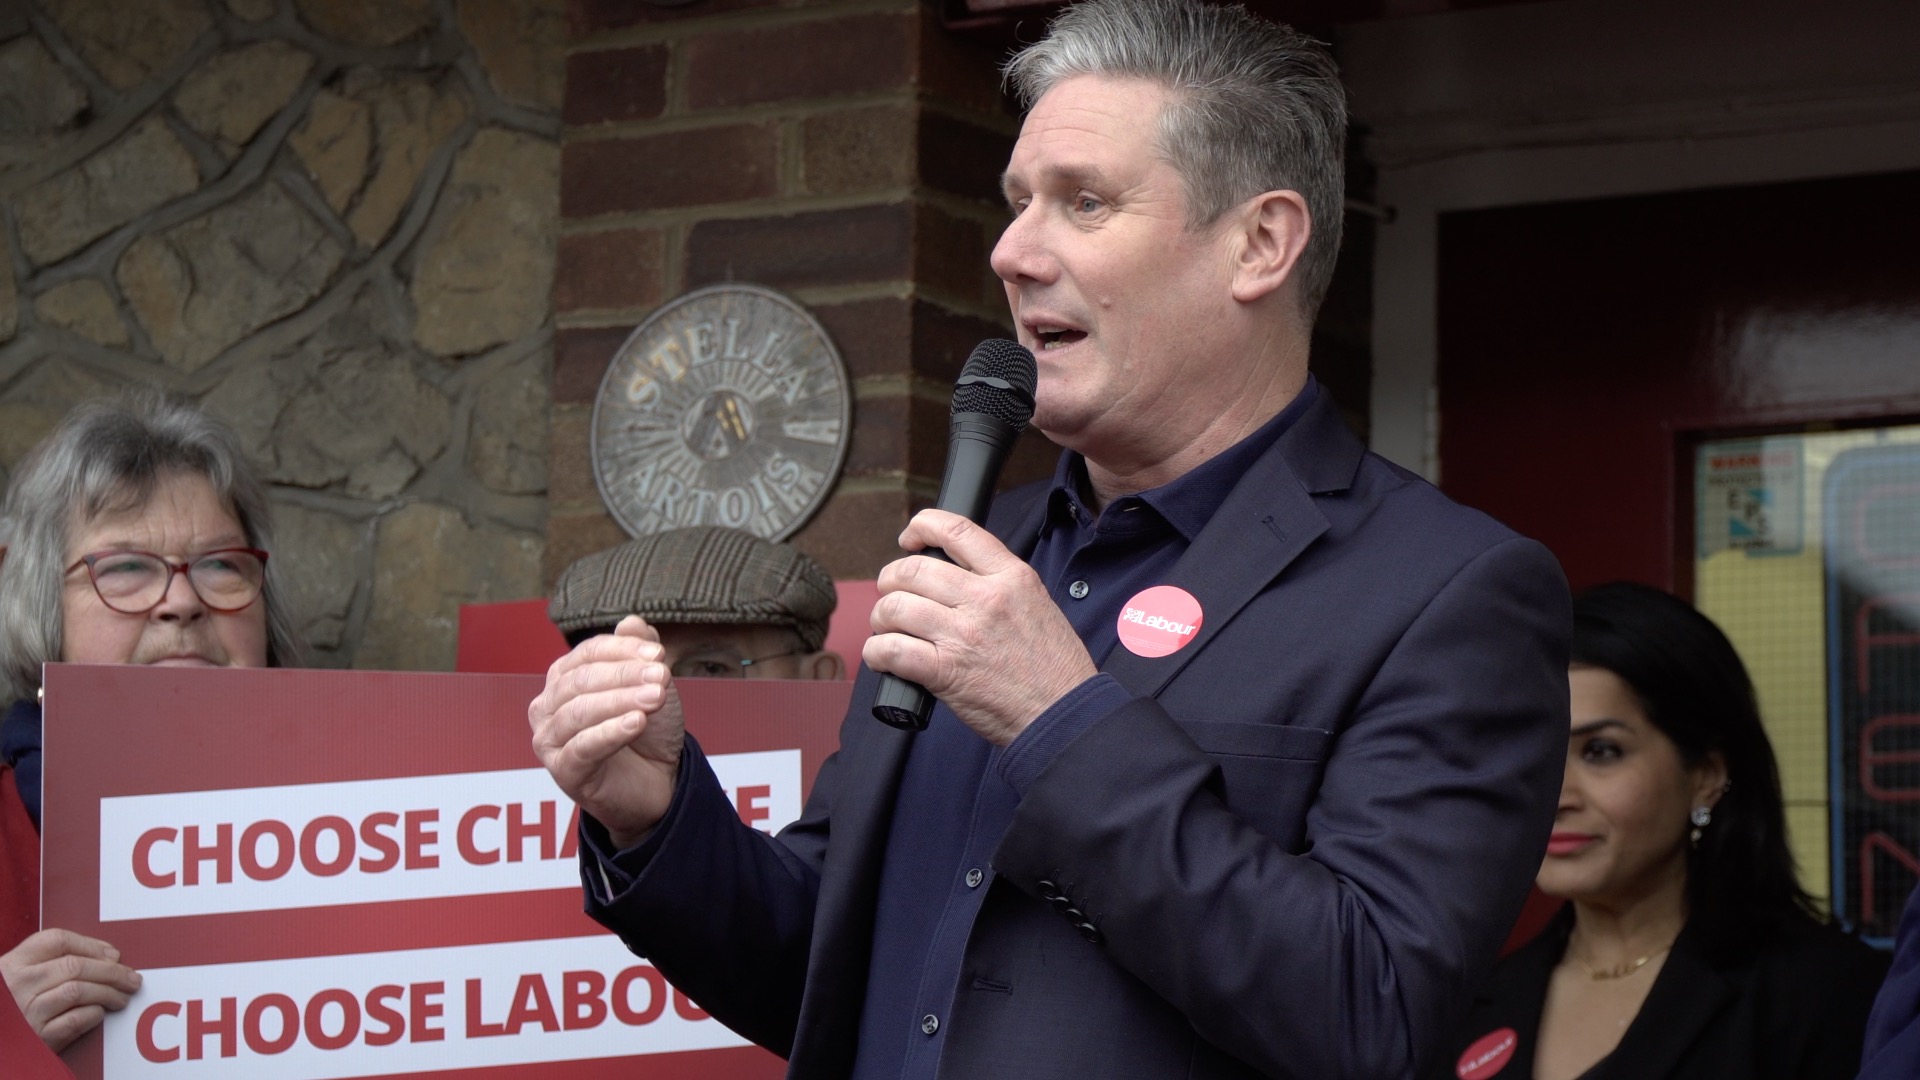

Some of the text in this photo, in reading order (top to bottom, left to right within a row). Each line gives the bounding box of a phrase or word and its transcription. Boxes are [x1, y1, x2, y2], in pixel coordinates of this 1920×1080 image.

[627, 318, 808, 410] STELLA
[628, 451, 801, 527] ARTOIS
[1137, 610, 1197, 636] Labour
[132, 785, 771, 888] CHOOSE CHE
[135, 965, 714, 1064] CHOOSE LABO
